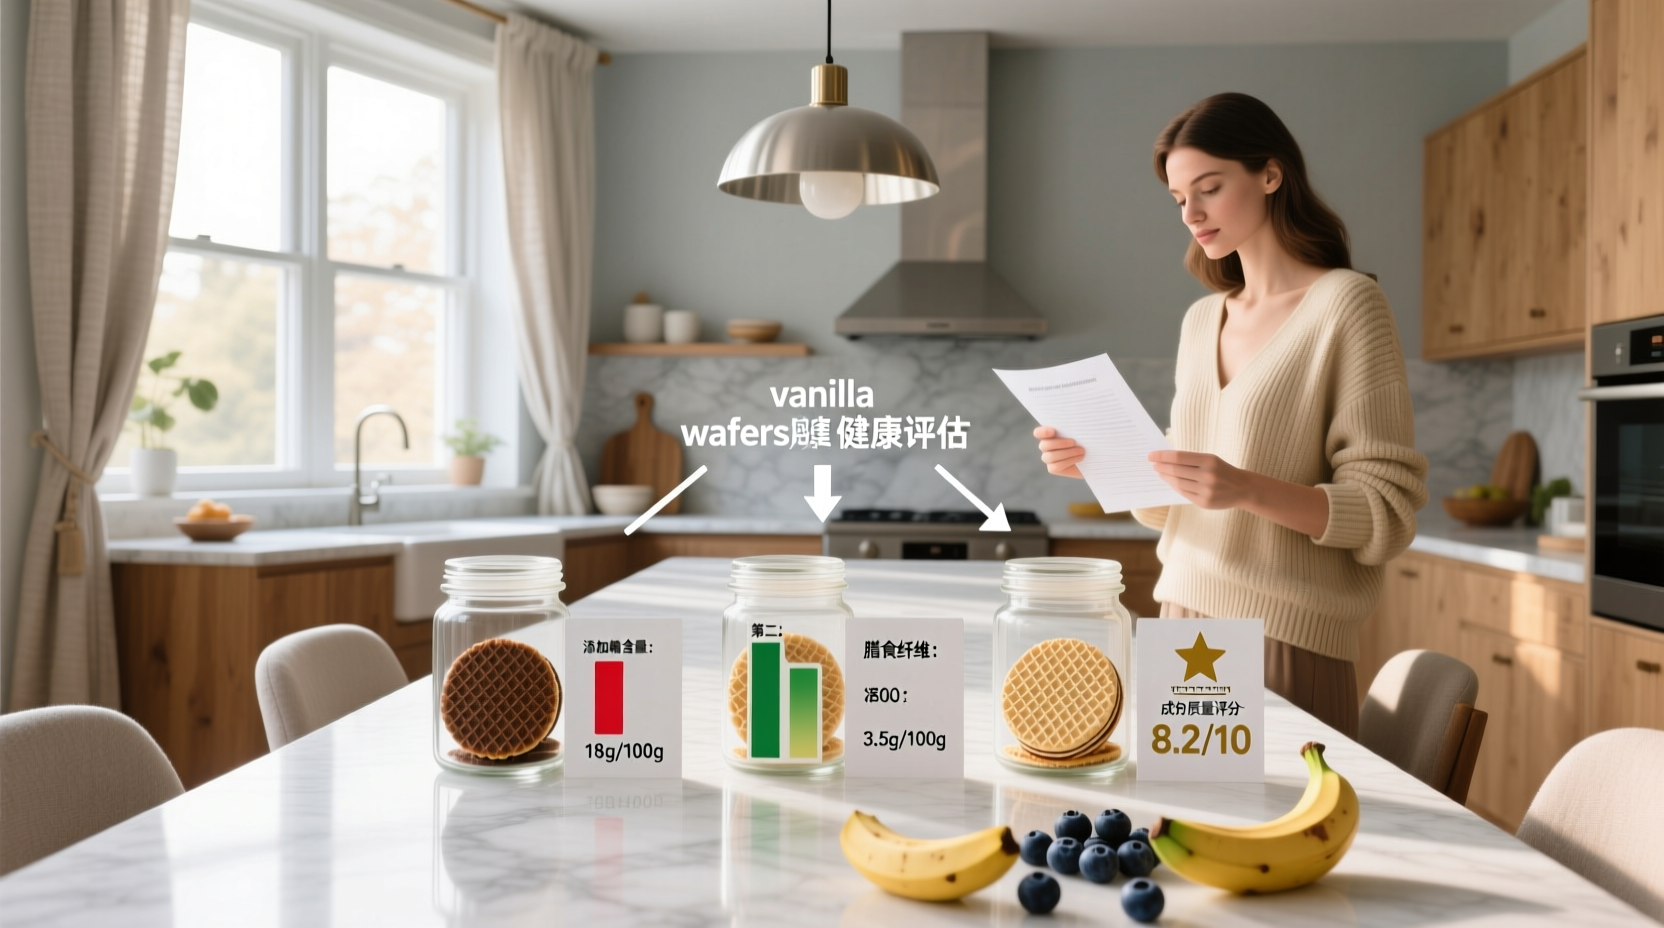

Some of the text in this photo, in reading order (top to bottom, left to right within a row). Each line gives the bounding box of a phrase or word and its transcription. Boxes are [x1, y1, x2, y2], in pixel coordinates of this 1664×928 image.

[863, 730, 946, 751] 3.5g/100g
[1151, 723, 1251, 756] 8.2/10
[585, 742, 664, 763] 18g/100g
